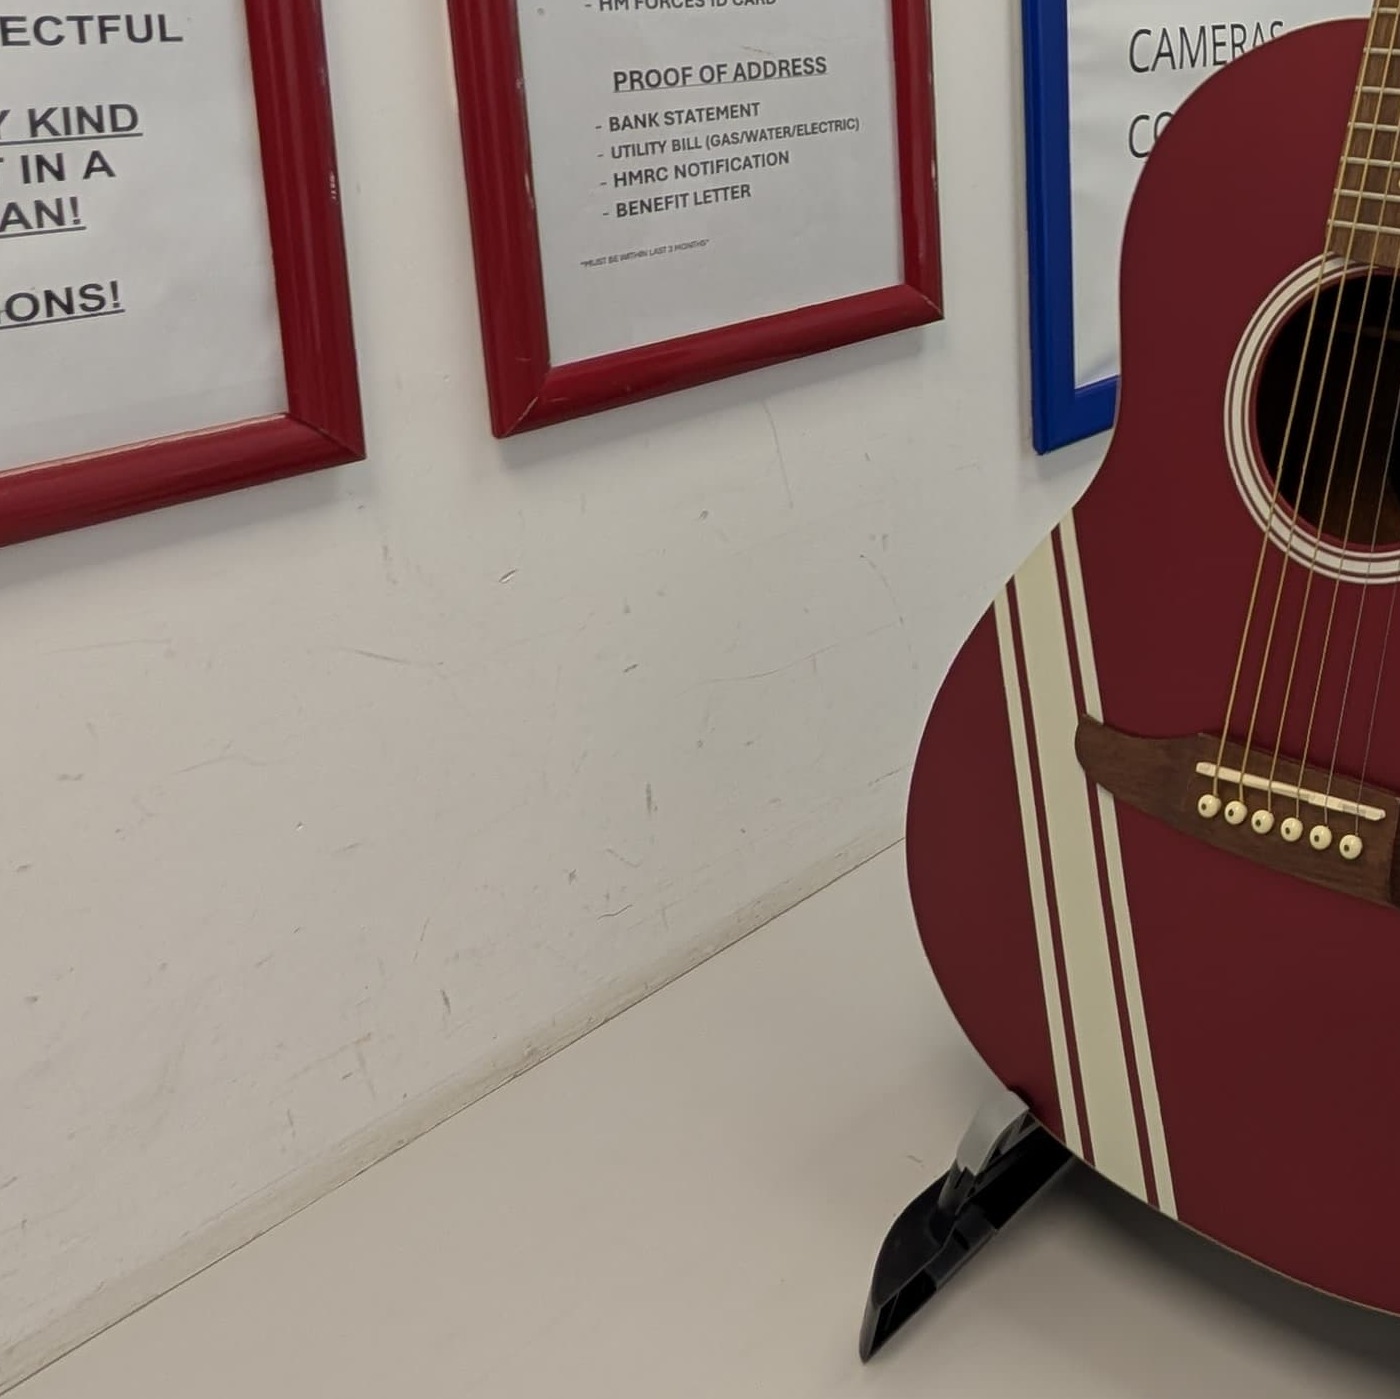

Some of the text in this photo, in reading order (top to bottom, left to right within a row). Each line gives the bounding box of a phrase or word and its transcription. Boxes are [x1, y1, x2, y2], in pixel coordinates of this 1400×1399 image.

[0, 14, 183, 46] ECTFUL
[613, 56, 827, 91] PROOF OF ADDRESS
[28, 103, 139, 138] KIND
[609, 102, 760, 132] BANK STATEMENT
[611, 117, 860, 159] UTILITY BILL (GAS/WATER/ELECTRIC)
[20, 150, 116, 184] IN A
[613, 151, 789, 188] HMRC NOTIFICATION
[616, 184, 751, 218] BENEFIT LETTER
[649, 246, 666, 256] LAST
[0, 281, 121, 322] ONS!
